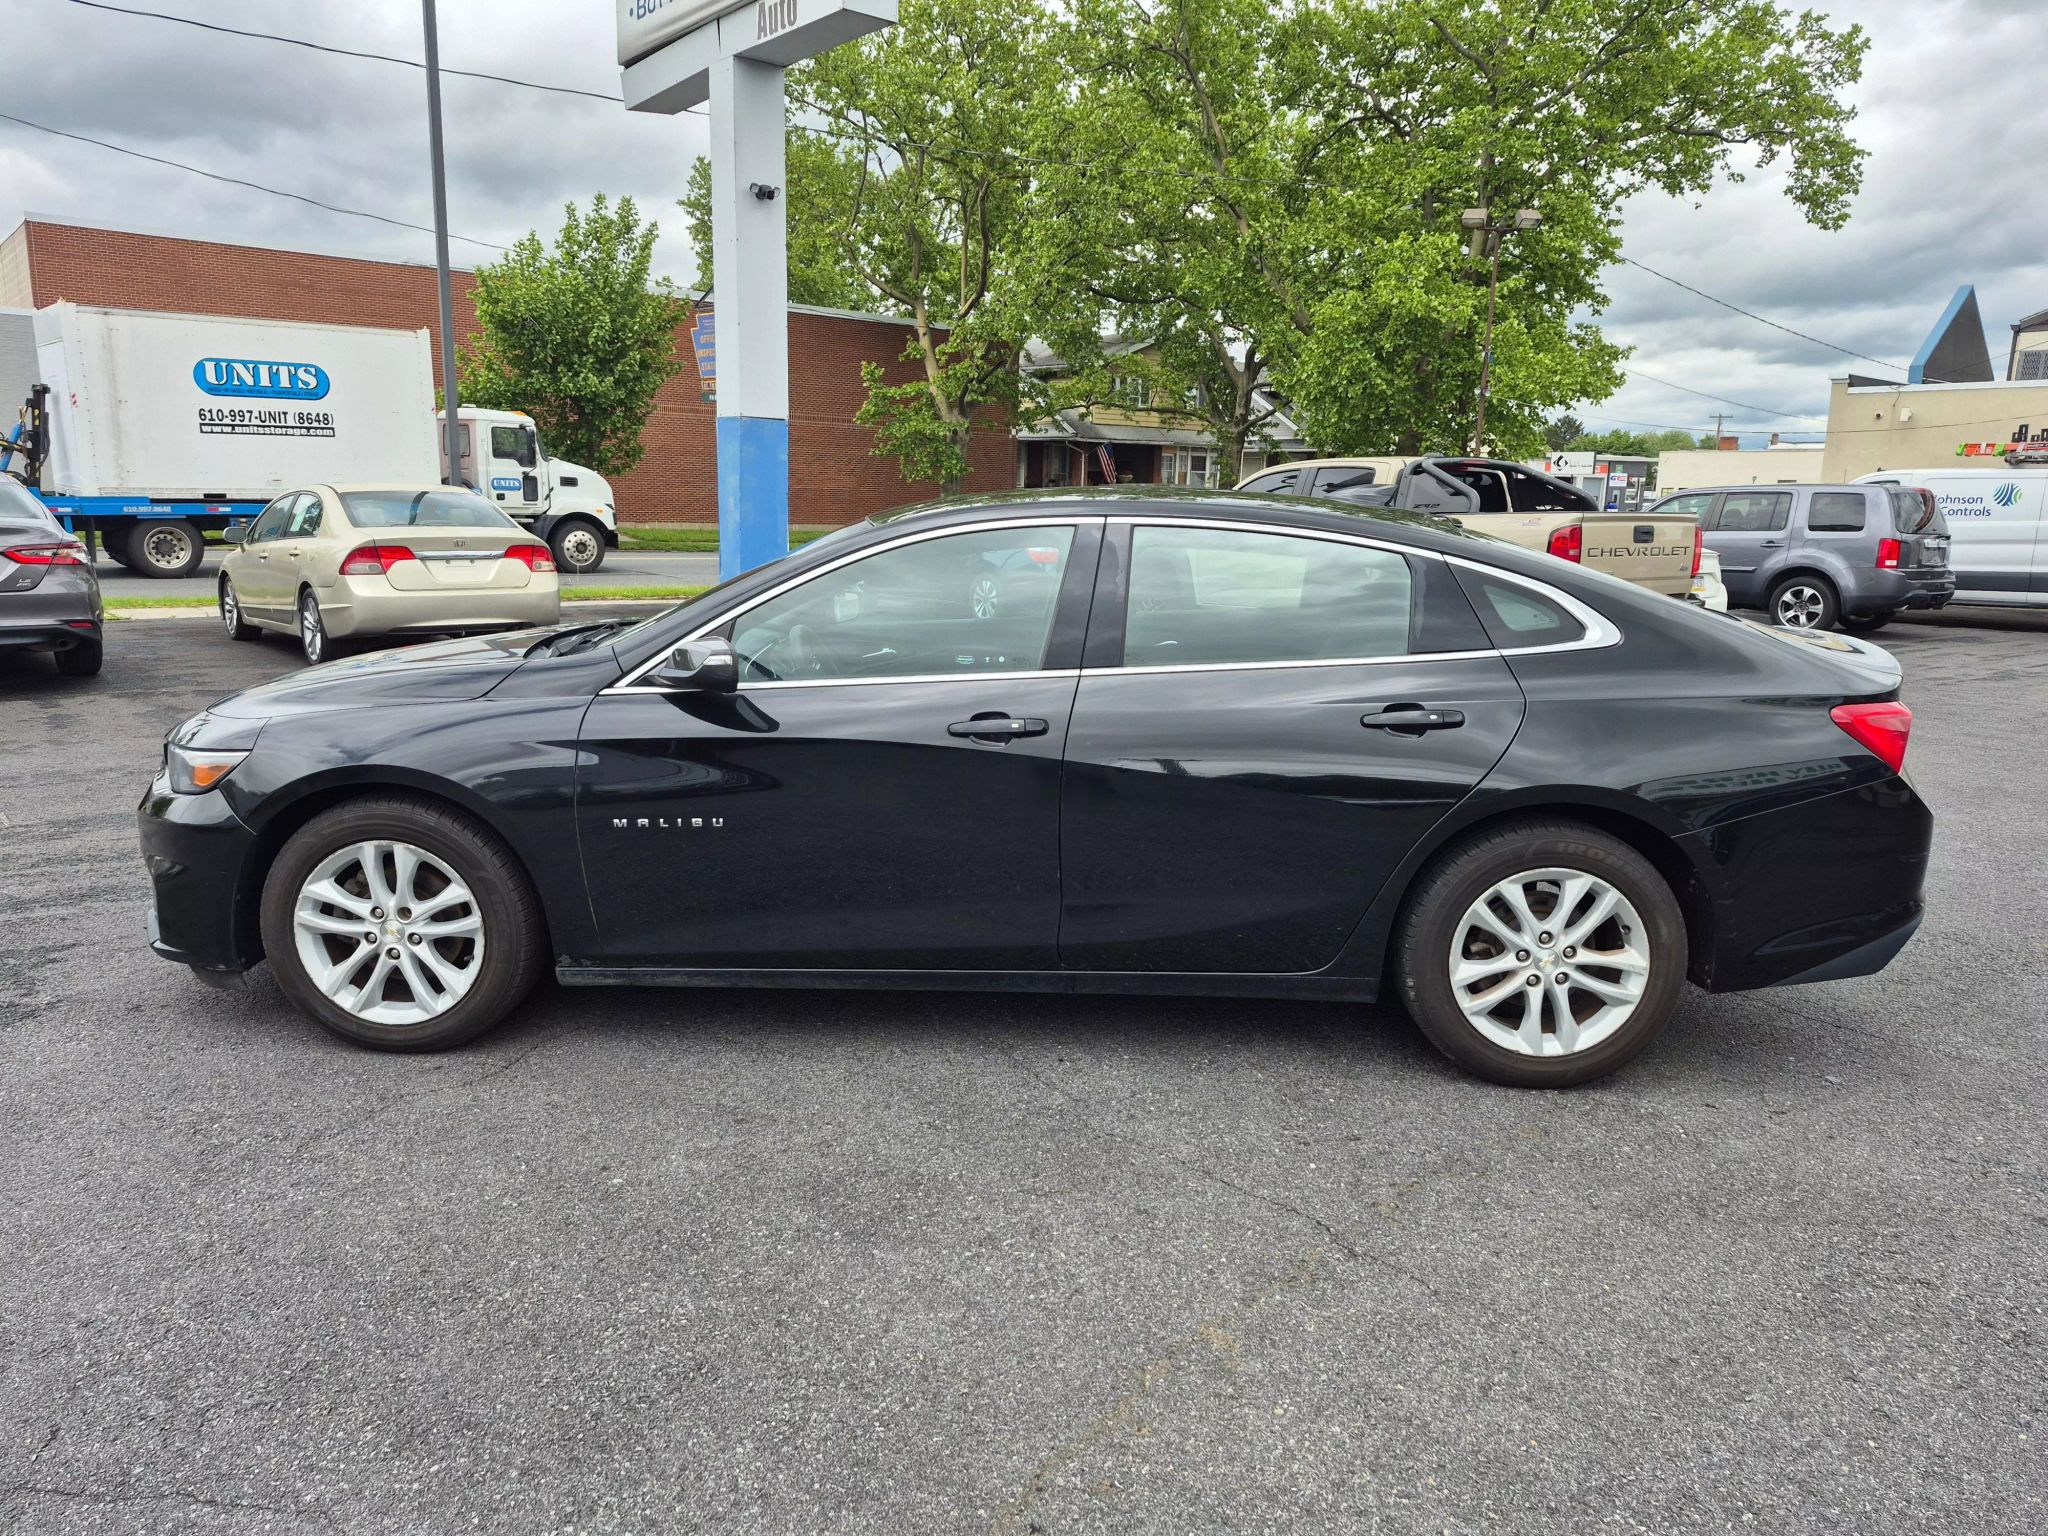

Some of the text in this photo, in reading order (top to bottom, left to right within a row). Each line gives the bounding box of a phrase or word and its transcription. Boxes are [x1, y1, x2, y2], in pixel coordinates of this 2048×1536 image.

[757, 0, 798, 40] Auto
[203, 360, 319, 389] UNITS
[199, 408, 334, 426] 610-997-UNIT (8648)
[200, 424, 334, 437] www.unitsstorage.com
[493, 479, 520, 487] UNITS
[1587, 546, 1691, 558] CHEVROLET
[612, 817, 724, 828] MALIBU
